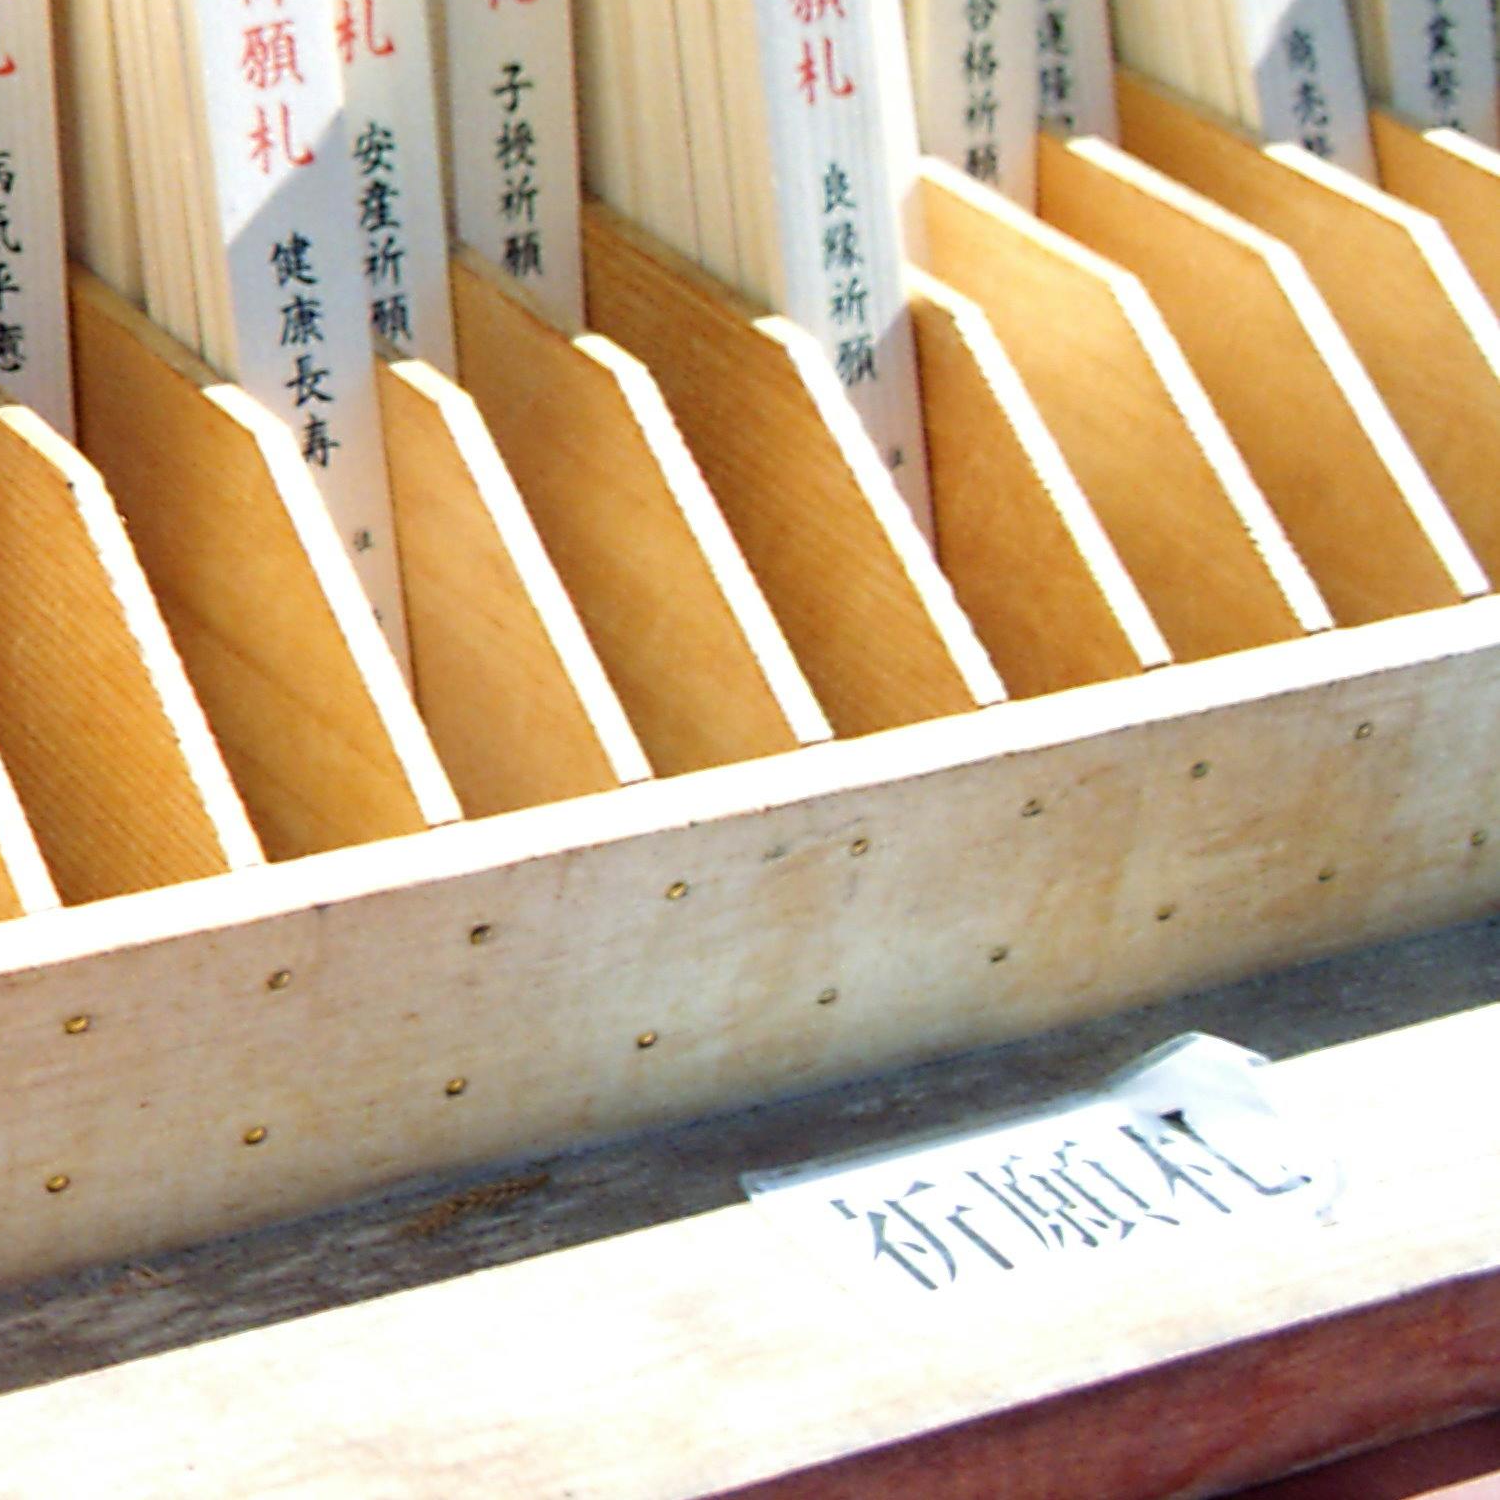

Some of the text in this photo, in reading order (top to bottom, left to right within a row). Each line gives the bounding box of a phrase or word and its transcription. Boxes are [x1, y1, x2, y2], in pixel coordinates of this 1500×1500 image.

[353, 123, 413, 342] 安産祈願
[491, 63, 545, 280] 子授祈願
[269, 231, 342, 469] 健康長寿
[831, 1108, 1312, 1291] 祈願札
